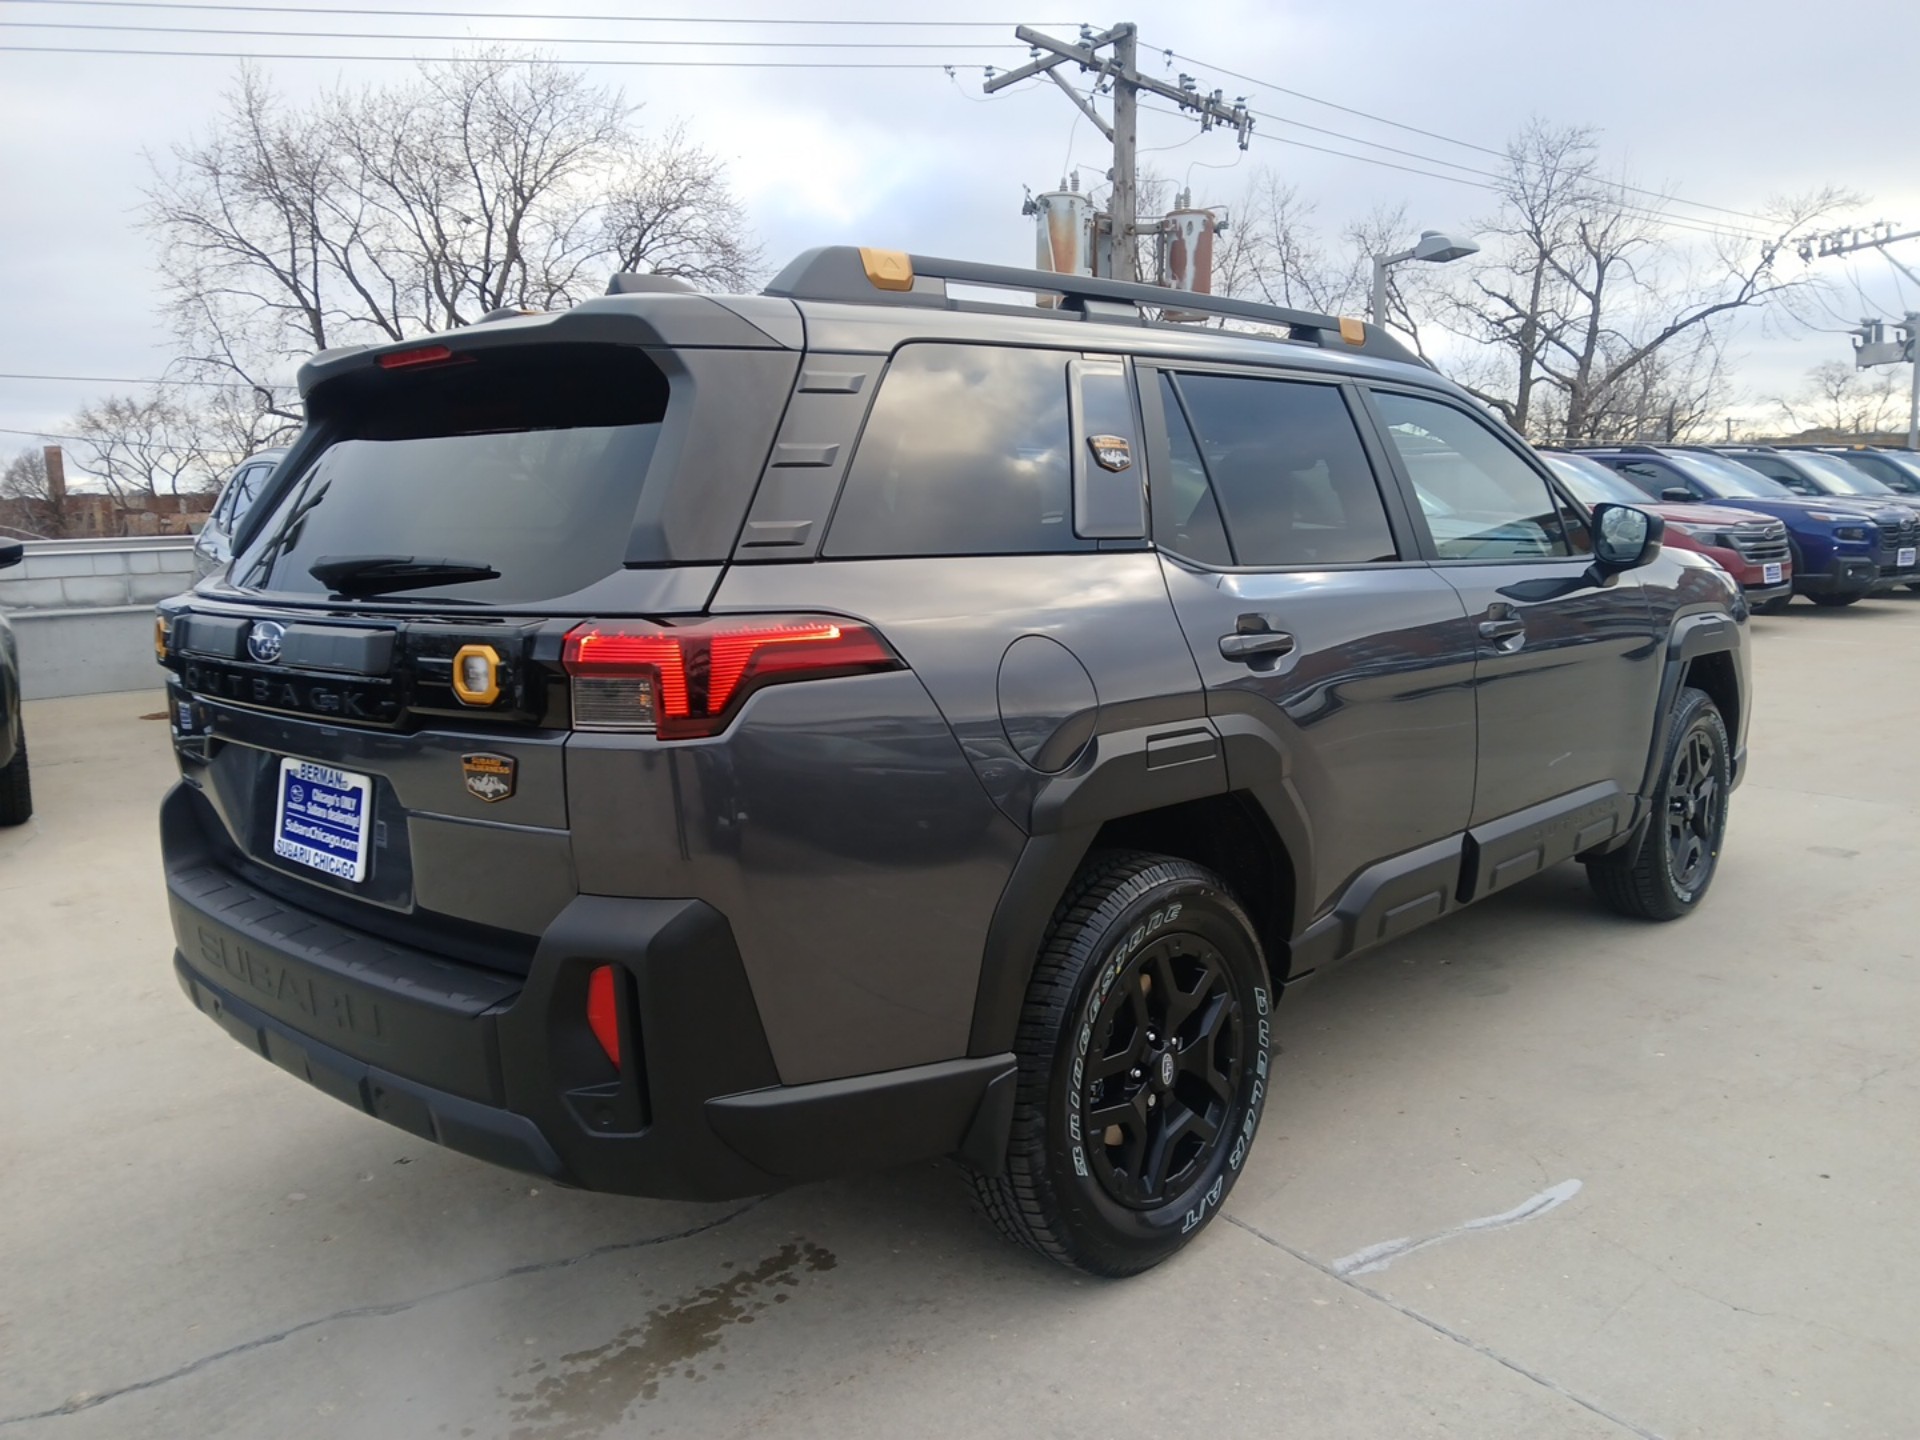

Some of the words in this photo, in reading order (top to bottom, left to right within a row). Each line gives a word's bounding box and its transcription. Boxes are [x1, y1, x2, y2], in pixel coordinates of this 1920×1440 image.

[185, 667, 365, 715] OUTBACK
[301, 763, 342, 788] BERMAN
[276, 839, 310, 864] SUBARU
[312, 852, 356, 880] CHICAGO
[198, 927, 383, 1038] SUBARU
[1070, 904, 1182, 1177] BRIDGESTONE
[1229, 987, 1270, 1171] DUELER
[1182, 1175, 1223, 1234] A/T
